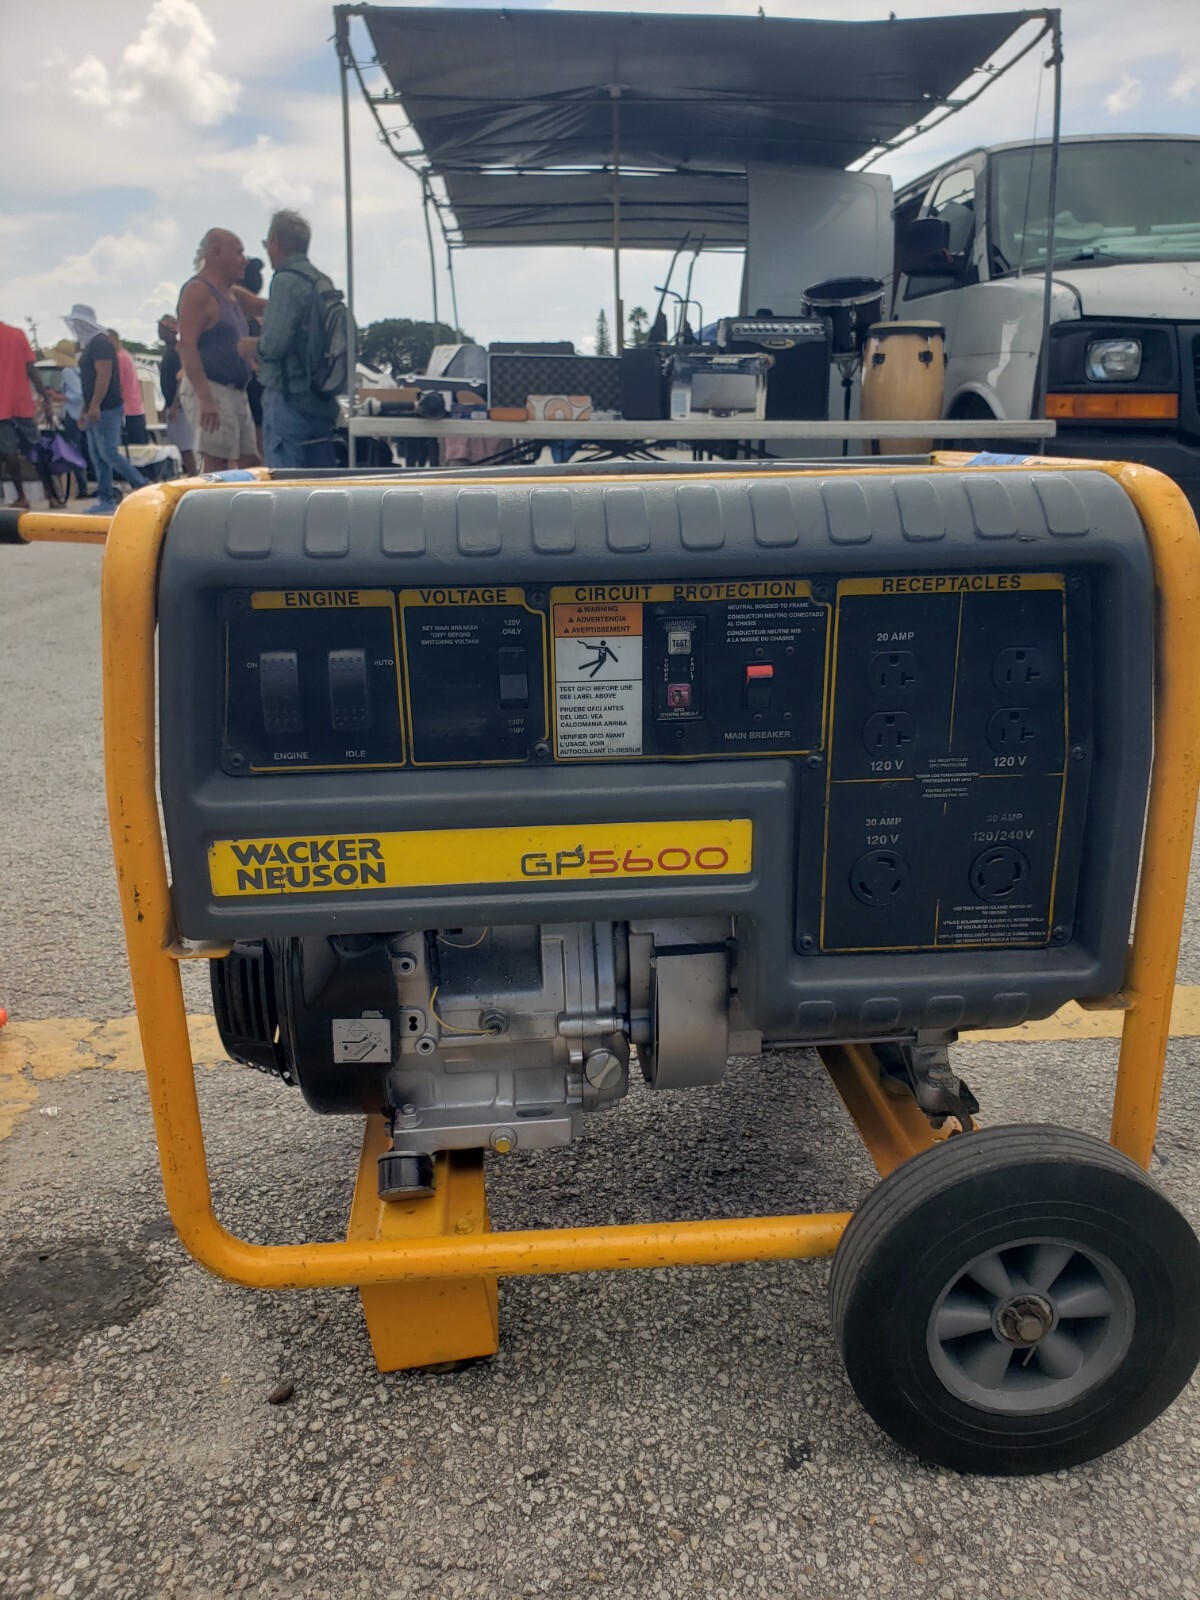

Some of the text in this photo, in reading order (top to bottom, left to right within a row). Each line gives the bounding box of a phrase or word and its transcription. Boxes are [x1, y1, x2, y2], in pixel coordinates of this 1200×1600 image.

[882, 575, 1021, 592] RECEPTACLES
[419, 589, 508, 604] VOLTAGE
[574, 583, 796, 602] CIRCUIT PROTECTION
[284, 591, 360, 606] ENGINE
[876, 631, 915, 642] 20 AMP
[671, 639, 688, 648] TEST
[373, 659, 394, 667] AUTO
[724, 730, 791, 741] MAIN BREAKER
[273, 751, 310, 761] ENGINE
[345, 749, 367, 758] IDLE
[870, 759, 905, 771] 120 V
[992, 755, 1028, 767] 120 V
[865, 817, 903, 827] 30 AMP
[1000, 812, 1024, 822] AMP
[866, 834, 901, 845] 120 V
[230, 838, 385, 867] WACKER
[520, 846, 729, 877] GP5600
[236, 861, 387, 891] NEUSON
